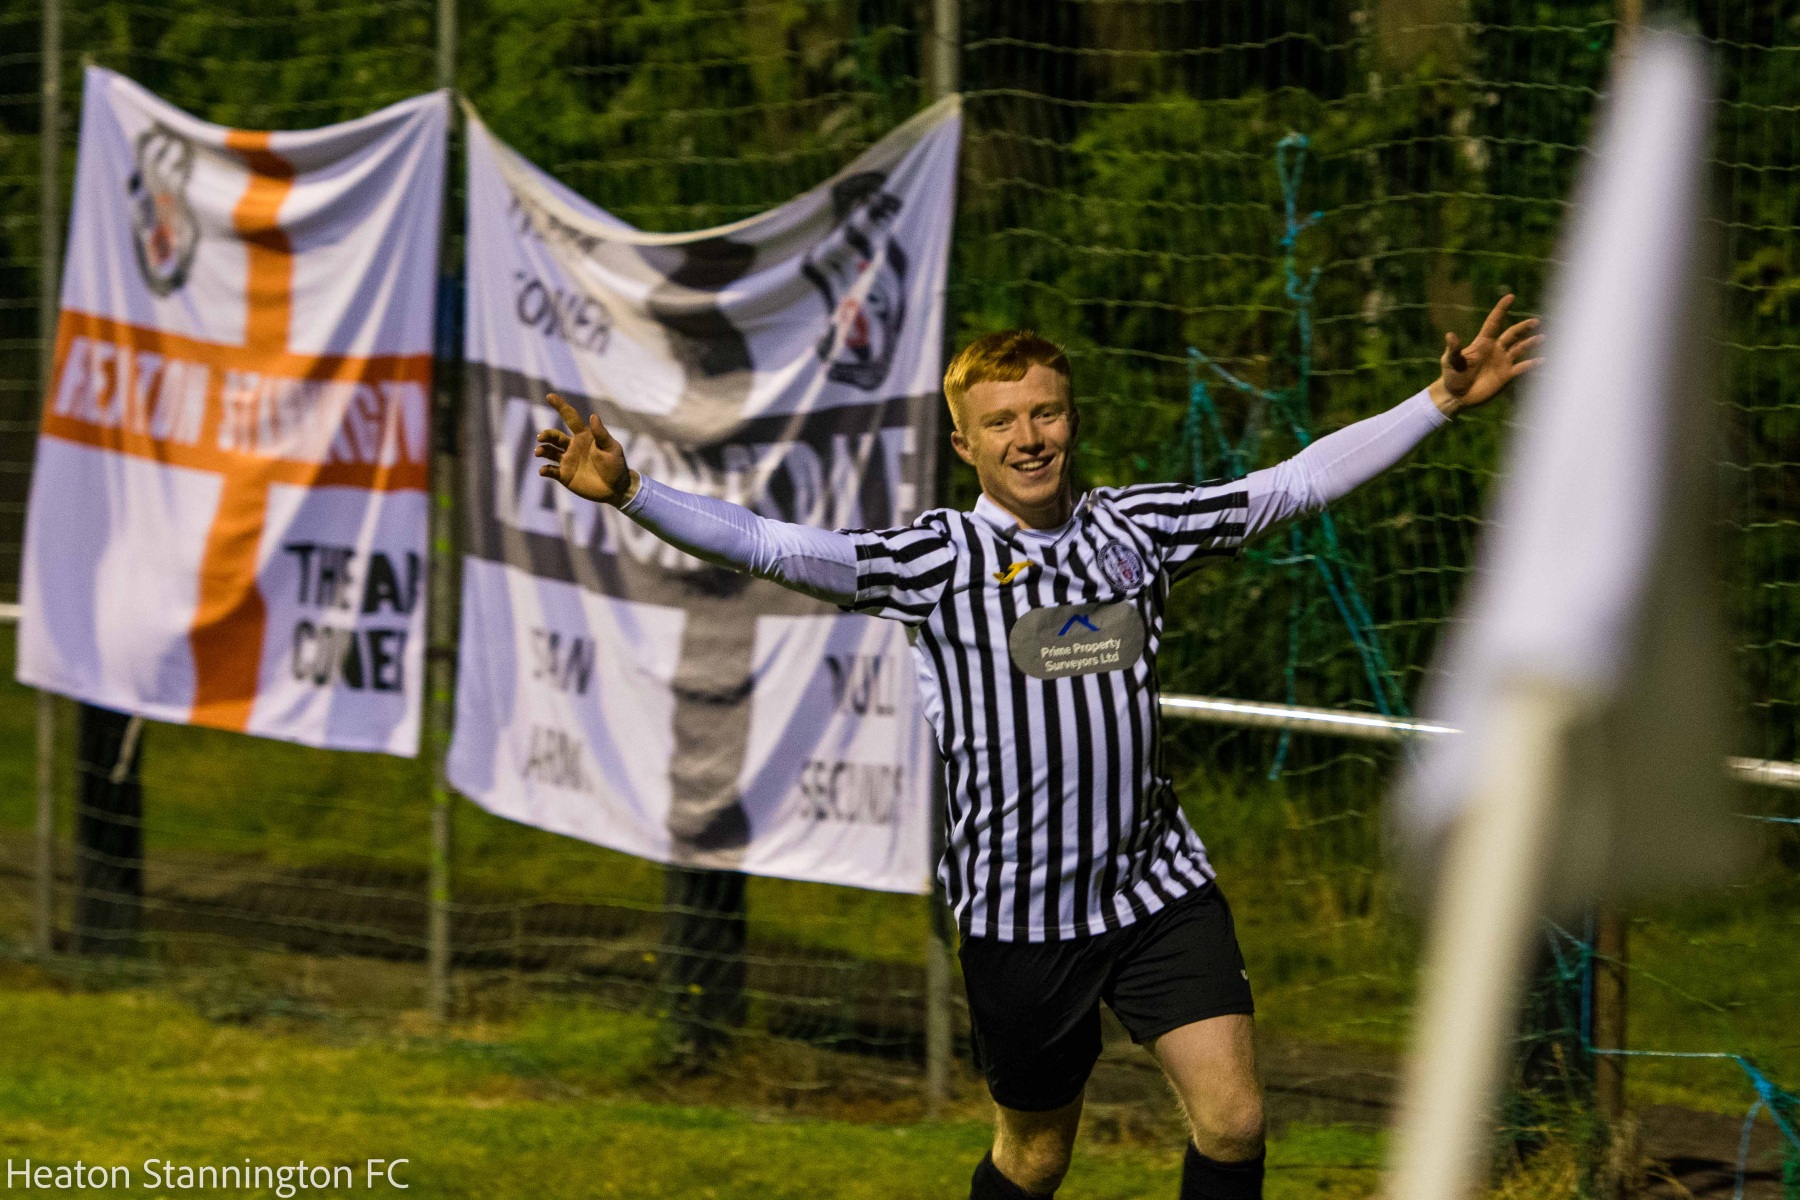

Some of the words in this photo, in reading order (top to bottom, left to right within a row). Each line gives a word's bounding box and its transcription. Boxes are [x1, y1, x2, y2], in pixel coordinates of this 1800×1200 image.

[1041, 646, 1072, 659] Prime
[1072, 638, 1121, 654] Property
[1045, 657, 1099, 672] Surveyors
[1100, 651, 1120, 665] Ltd
